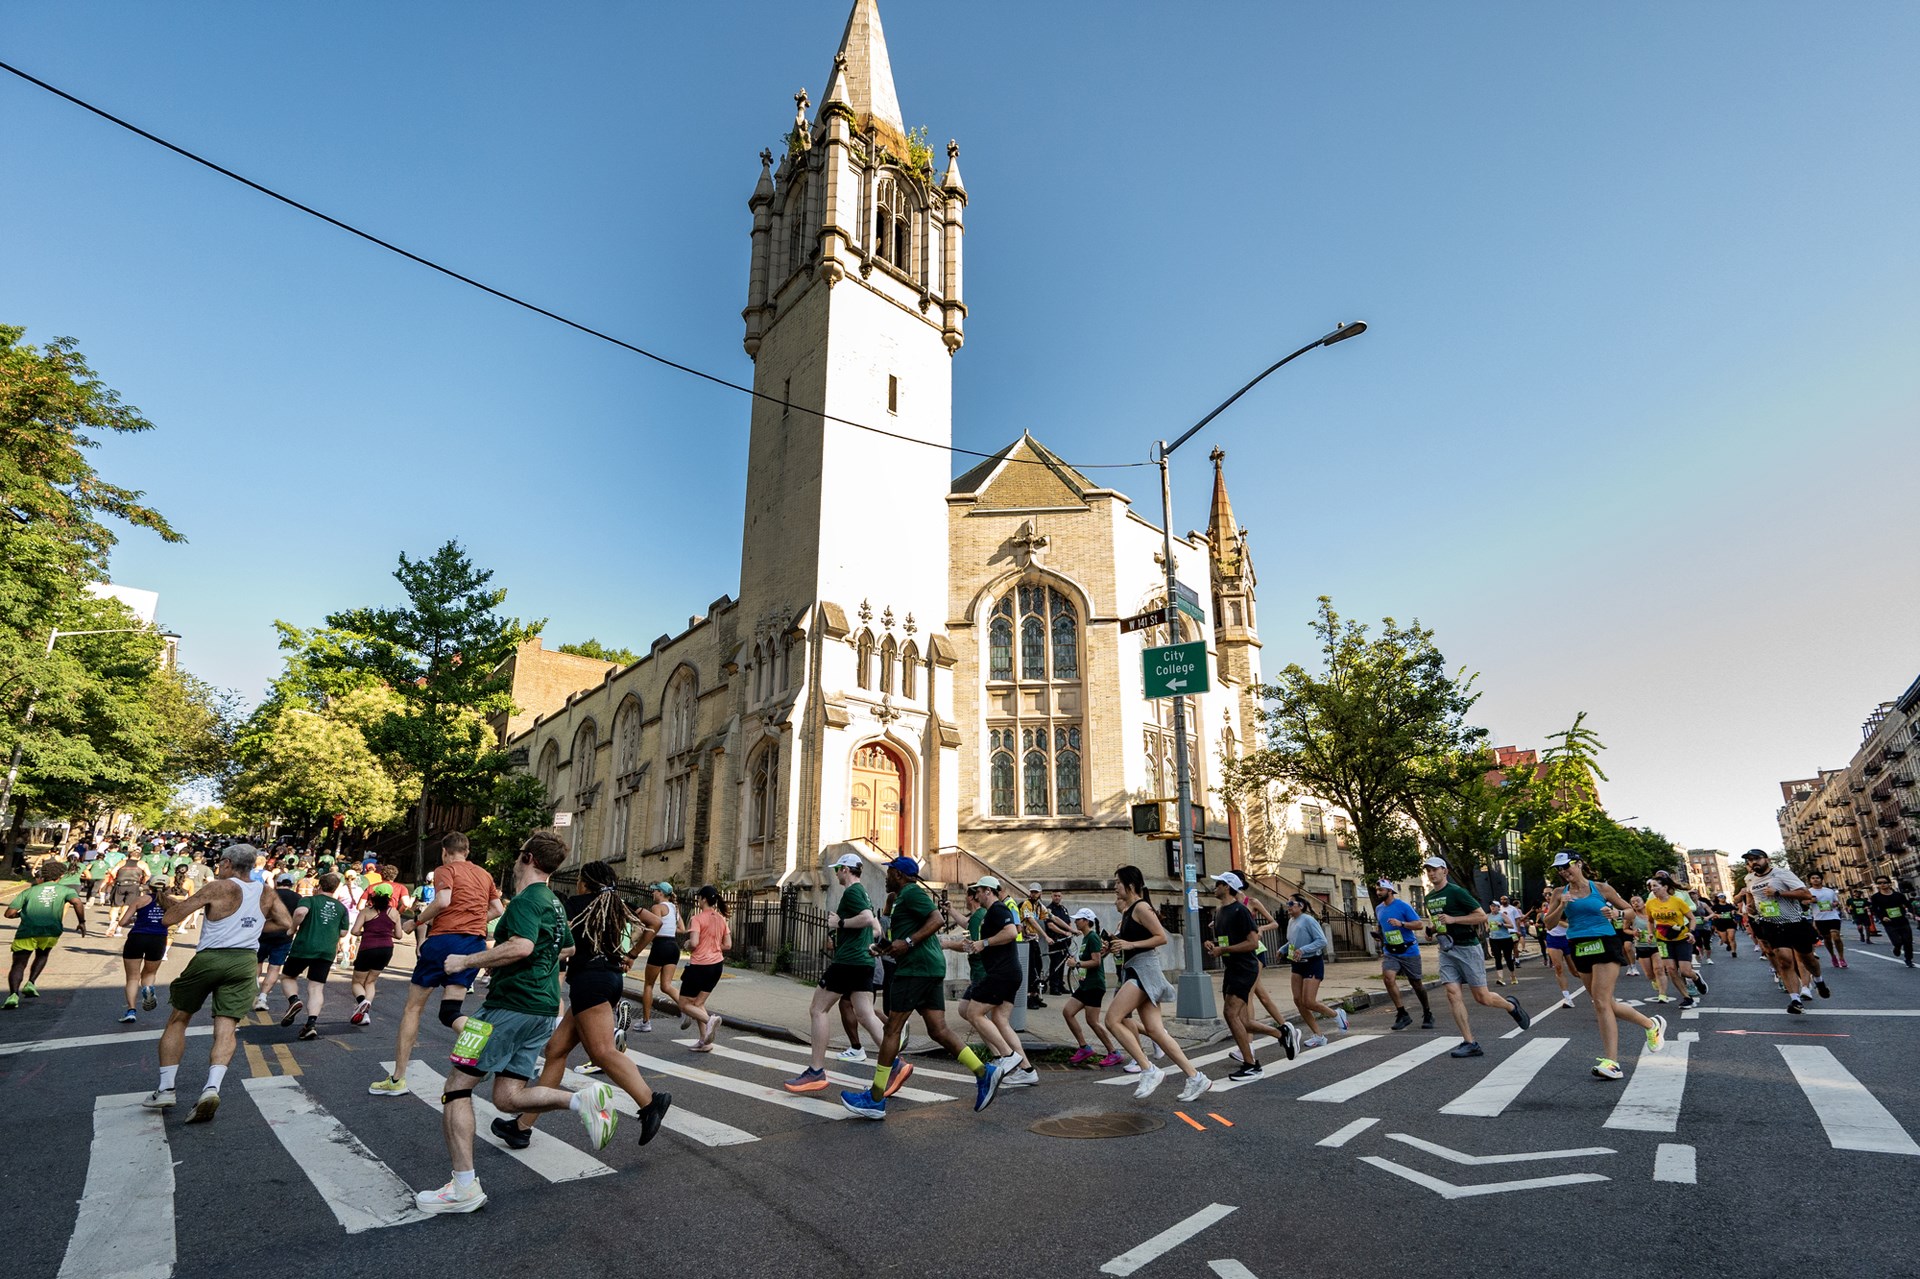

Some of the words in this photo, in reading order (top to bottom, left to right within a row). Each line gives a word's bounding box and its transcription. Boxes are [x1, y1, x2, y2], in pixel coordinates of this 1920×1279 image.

[1129, 620, 1136, 630] W
[1137, 618, 1148, 628] 141
[1150, 614, 1158, 625] St
[1163, 651, 1185, 662] City
[1156, 663, 1194, 676] College
[458, 1030, 484, 1048] 2977
